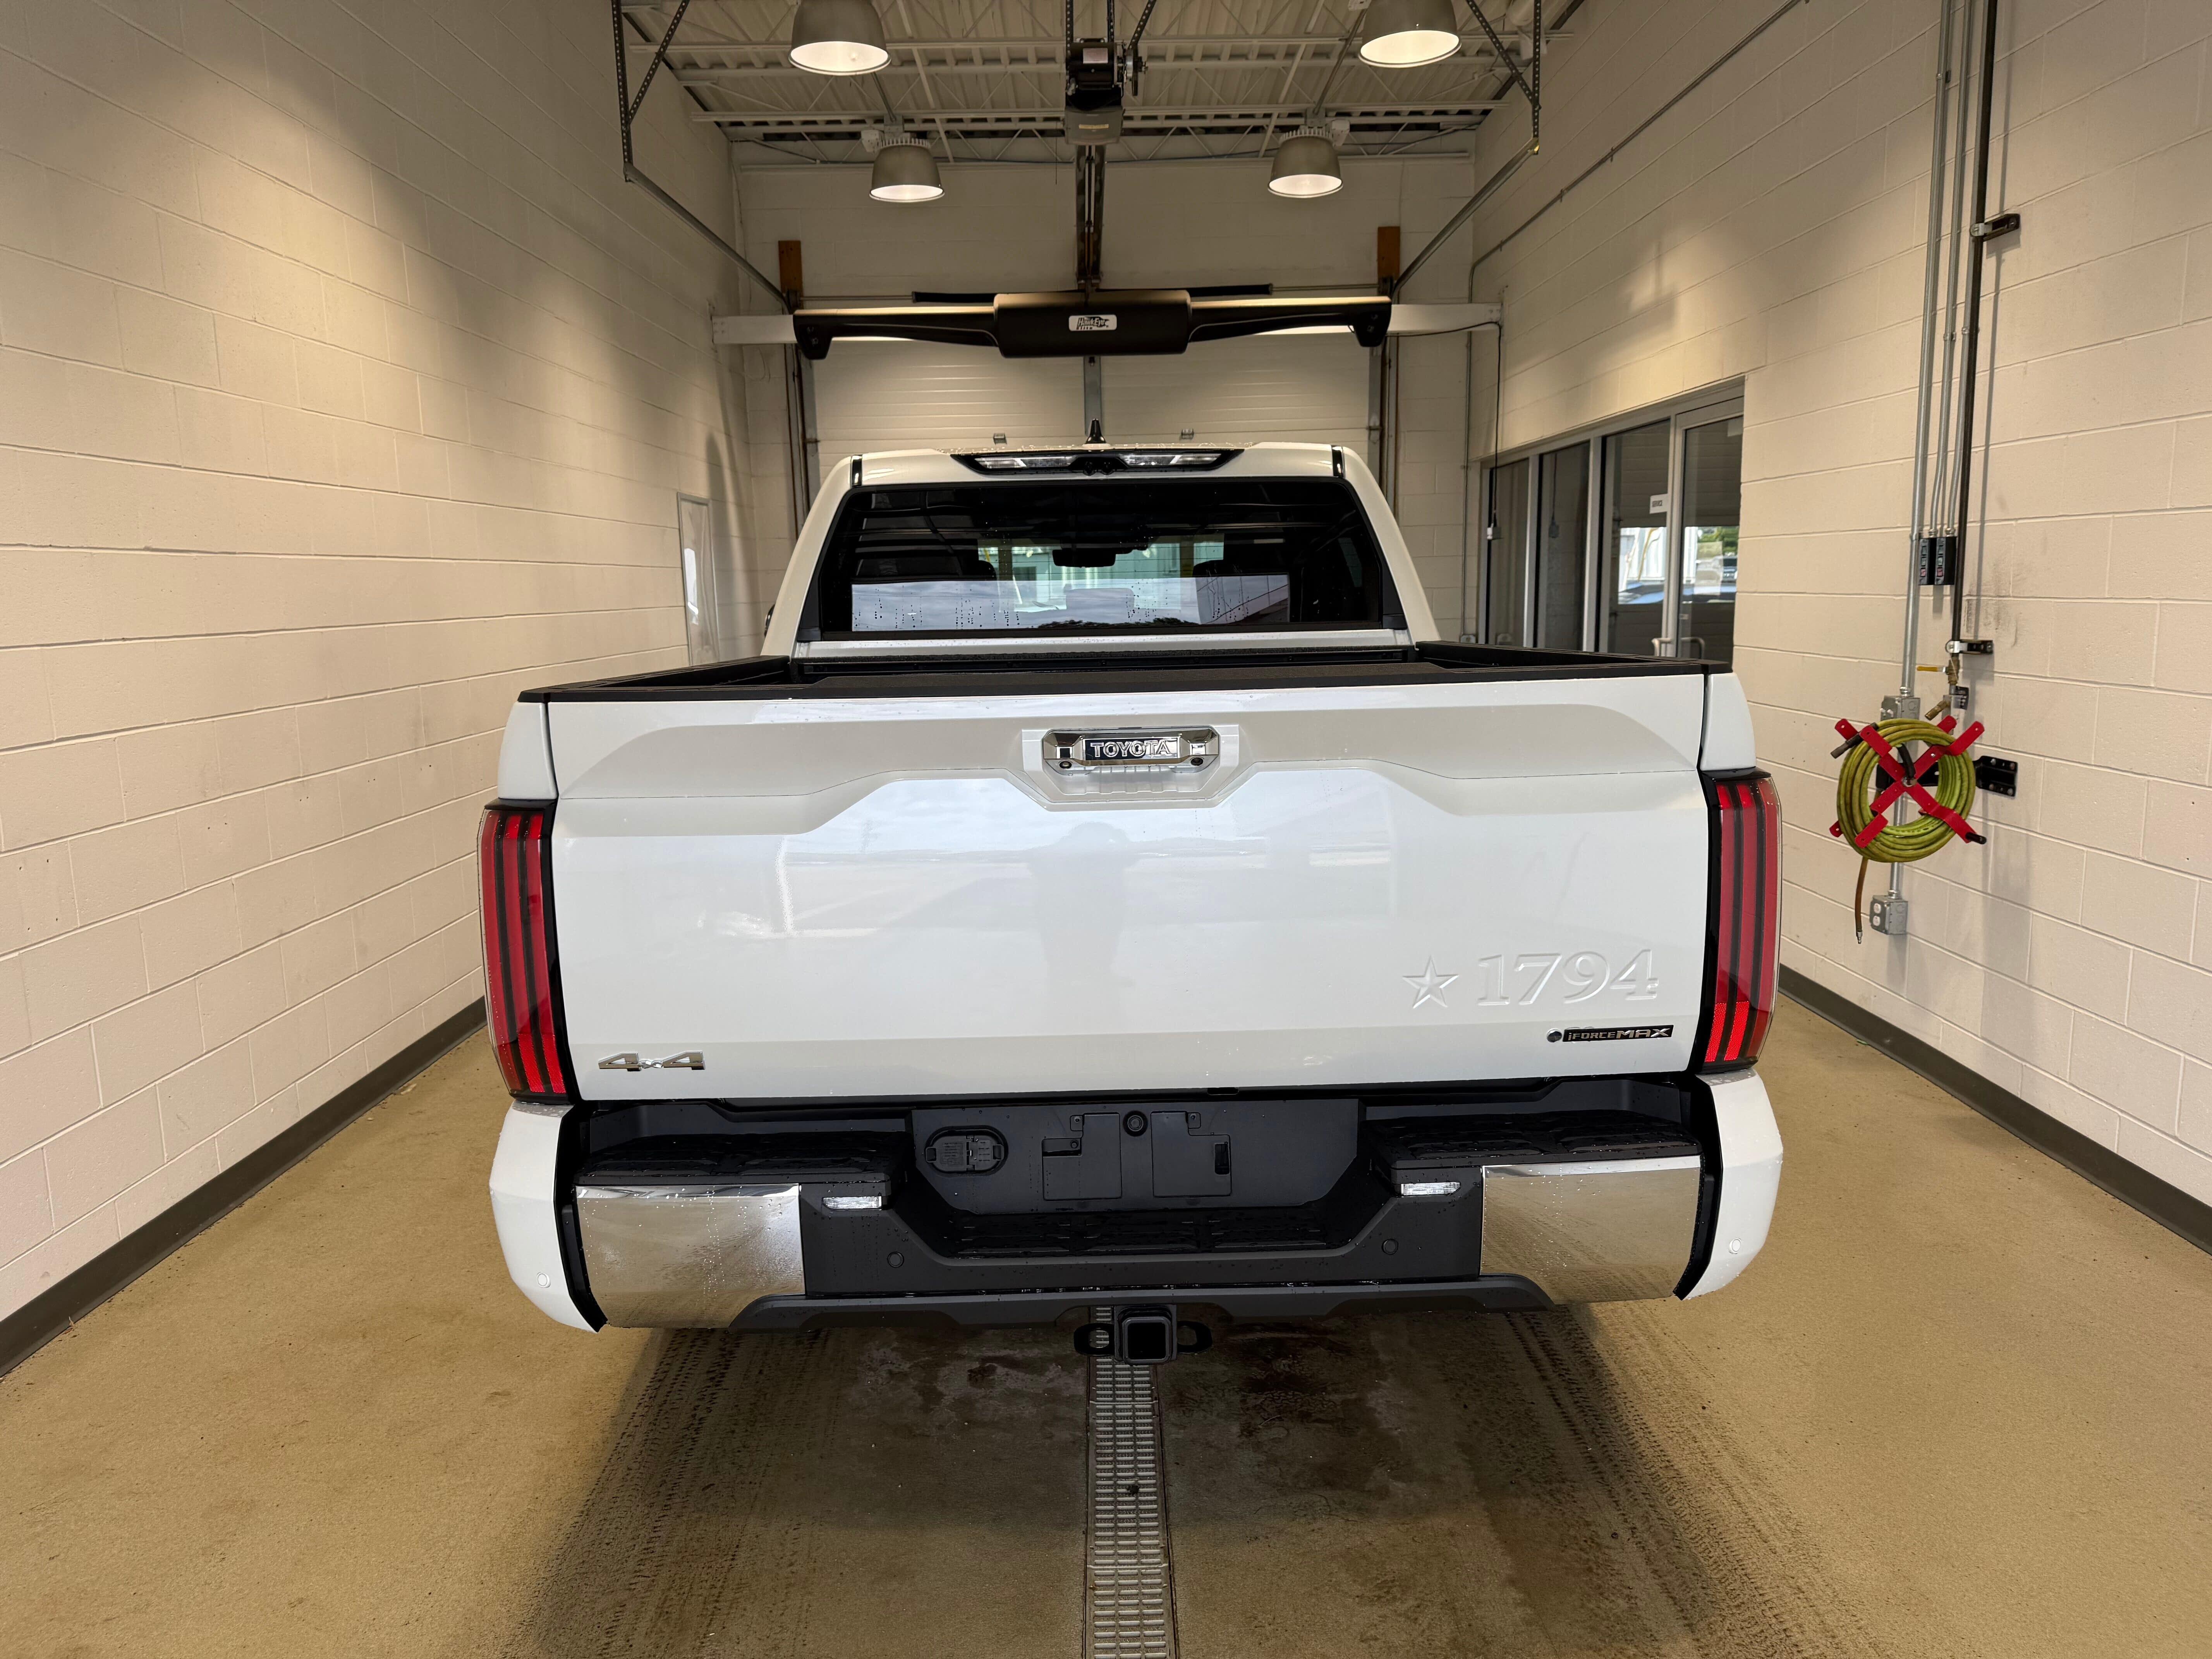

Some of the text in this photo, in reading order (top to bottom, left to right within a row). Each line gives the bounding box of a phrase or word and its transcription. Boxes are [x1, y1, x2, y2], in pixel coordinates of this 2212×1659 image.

[1091, 740, 1173, 757] TOYOTA
[1476, 948, 1659, 1006] 1794
[598, 1050, 706, 1072] 4x4
